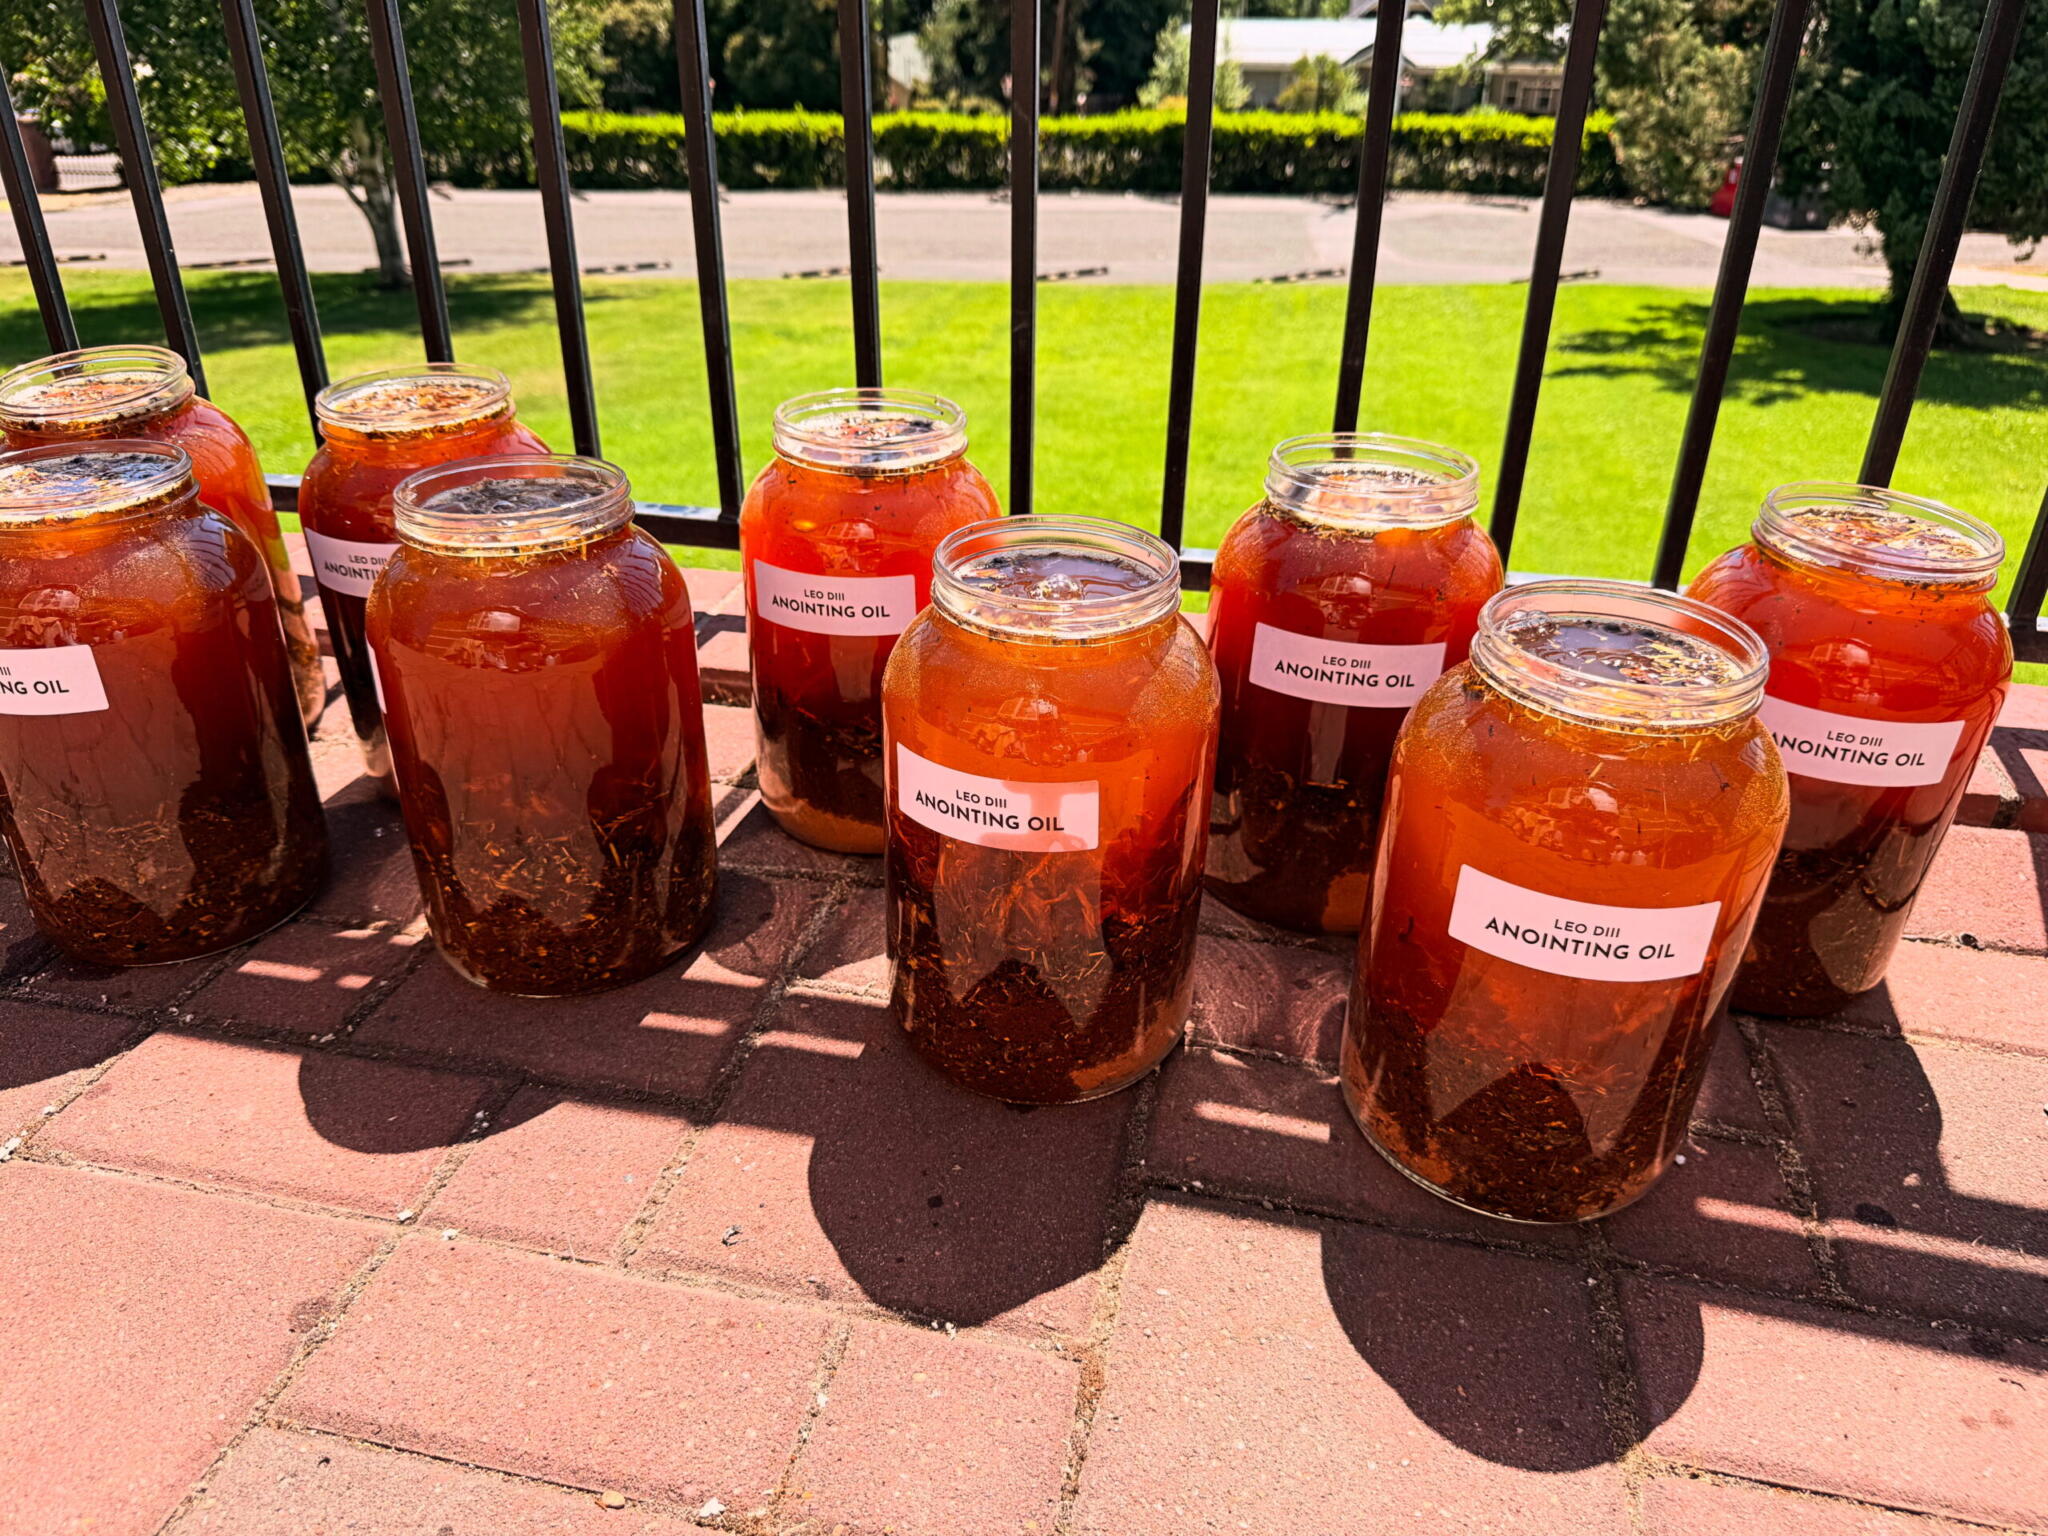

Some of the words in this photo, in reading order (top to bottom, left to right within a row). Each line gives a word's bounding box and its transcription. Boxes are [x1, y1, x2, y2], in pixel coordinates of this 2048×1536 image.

[348, 554, 369, 565] LEO
[324, 560, 380, 580] ANOINTI
[804, 589, 824, 600] LEO
[827, 592, 845, 601] DIII
[772, 595, 856, 618] ANOINTING
[861, 605, 891, 619] OIL
[1322, 655, 1347, 667] LEO
[1350, 658, 1372, 669] DIII
[1274, 660, 1379, 688] ANOINTING
[1385, 674, 1415, 688] OIL
[33, 680, 70, 695] OIL
[1826, 730, 1855, 744] LEO
[1859, 736, 1883, 747] DIII
[1895, 753, 1926, 767] OIL
[955, 789, 981, 804] LEO
[985, 796, 1007, 809] DIII
[915, 789, 1020, 830] ANOINTING
[1027, 816, 1065, 832] OIL
[1484, 916, 1630, 960] ANOINTING
[1638, 943, 1675, 960] OIL
[1553, 918, 1588, 934] LEO
[1592, 925, 1621, 938] DIII
